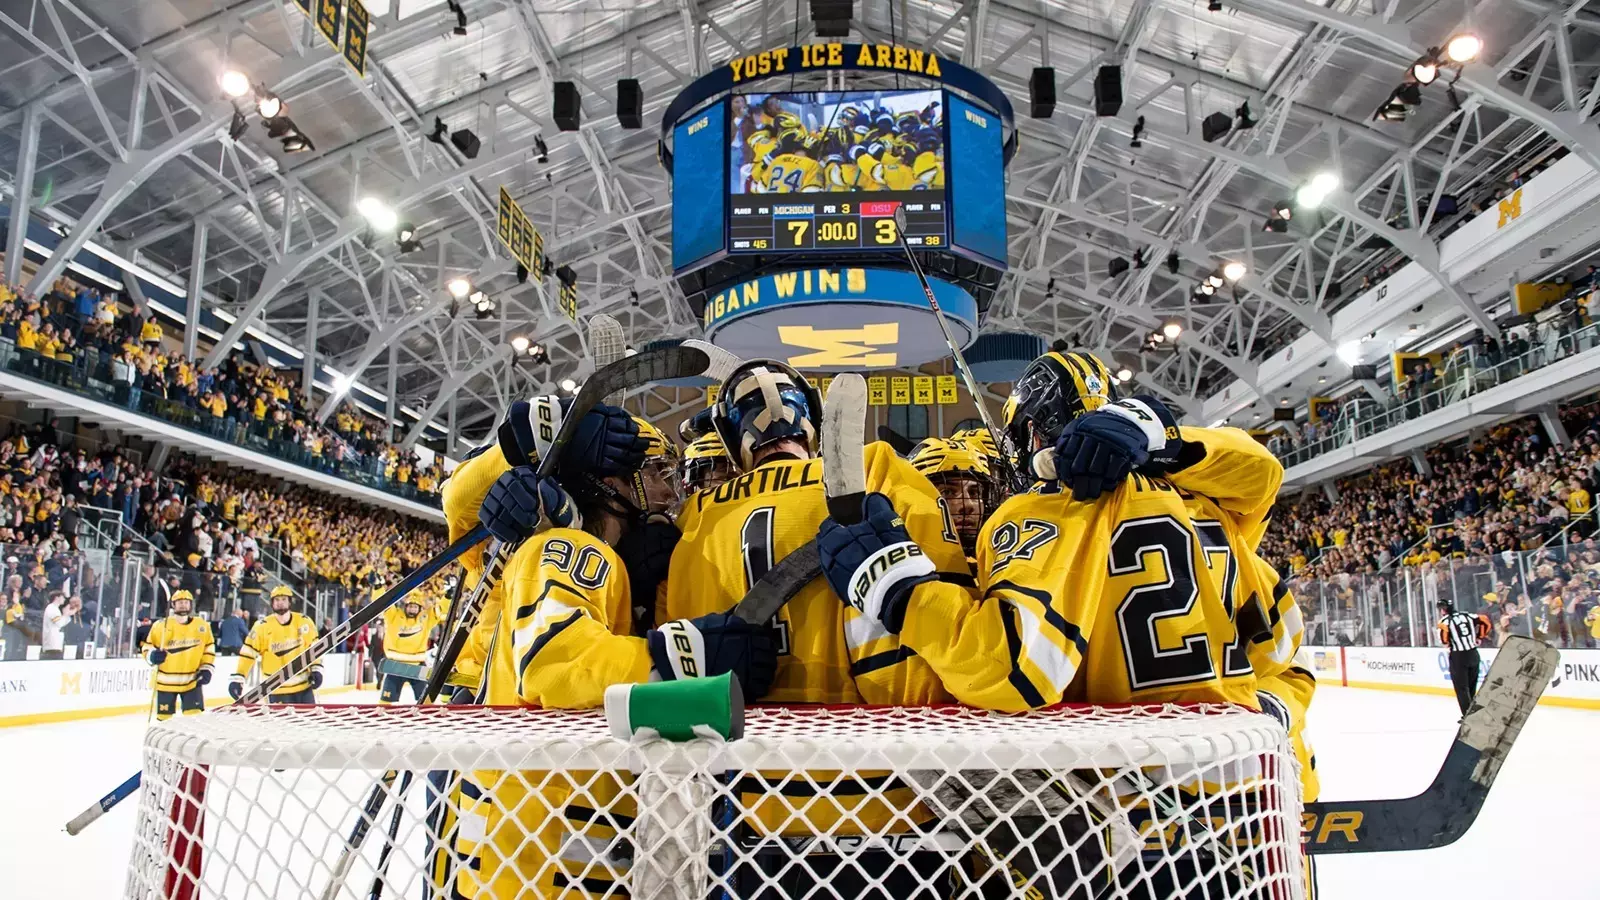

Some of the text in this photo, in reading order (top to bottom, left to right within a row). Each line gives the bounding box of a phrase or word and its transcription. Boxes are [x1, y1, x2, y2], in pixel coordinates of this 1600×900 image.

[730, 43, 941, 81] YOST ICE ARENA
[688, 116, 708, 135] WINS
[965, 109, 987, 128] WINS
[768, 166, 802, 192] 24
[774, 205, 815, 215] MICHIGAN
[823, 203, 850, 214] PER 3
[871, 204, 891, 213] OSU
[753, 240, 767, 248] 45
[787, 221, 809, 246] 7
[817, 222, 857, 241] :00.0
[875, 219, 896, 244] 3
[925, 236, 940, 245] 38
[774, 268, 866, 299] WINS
[698, 462, 824, 513] PORTILL
[990, 518, 1060, 578] 27
[541, 537, 612, 591] 90
[740, 505, 791, 656] 1
[88, 669, 135, 695] MICHIGAN
